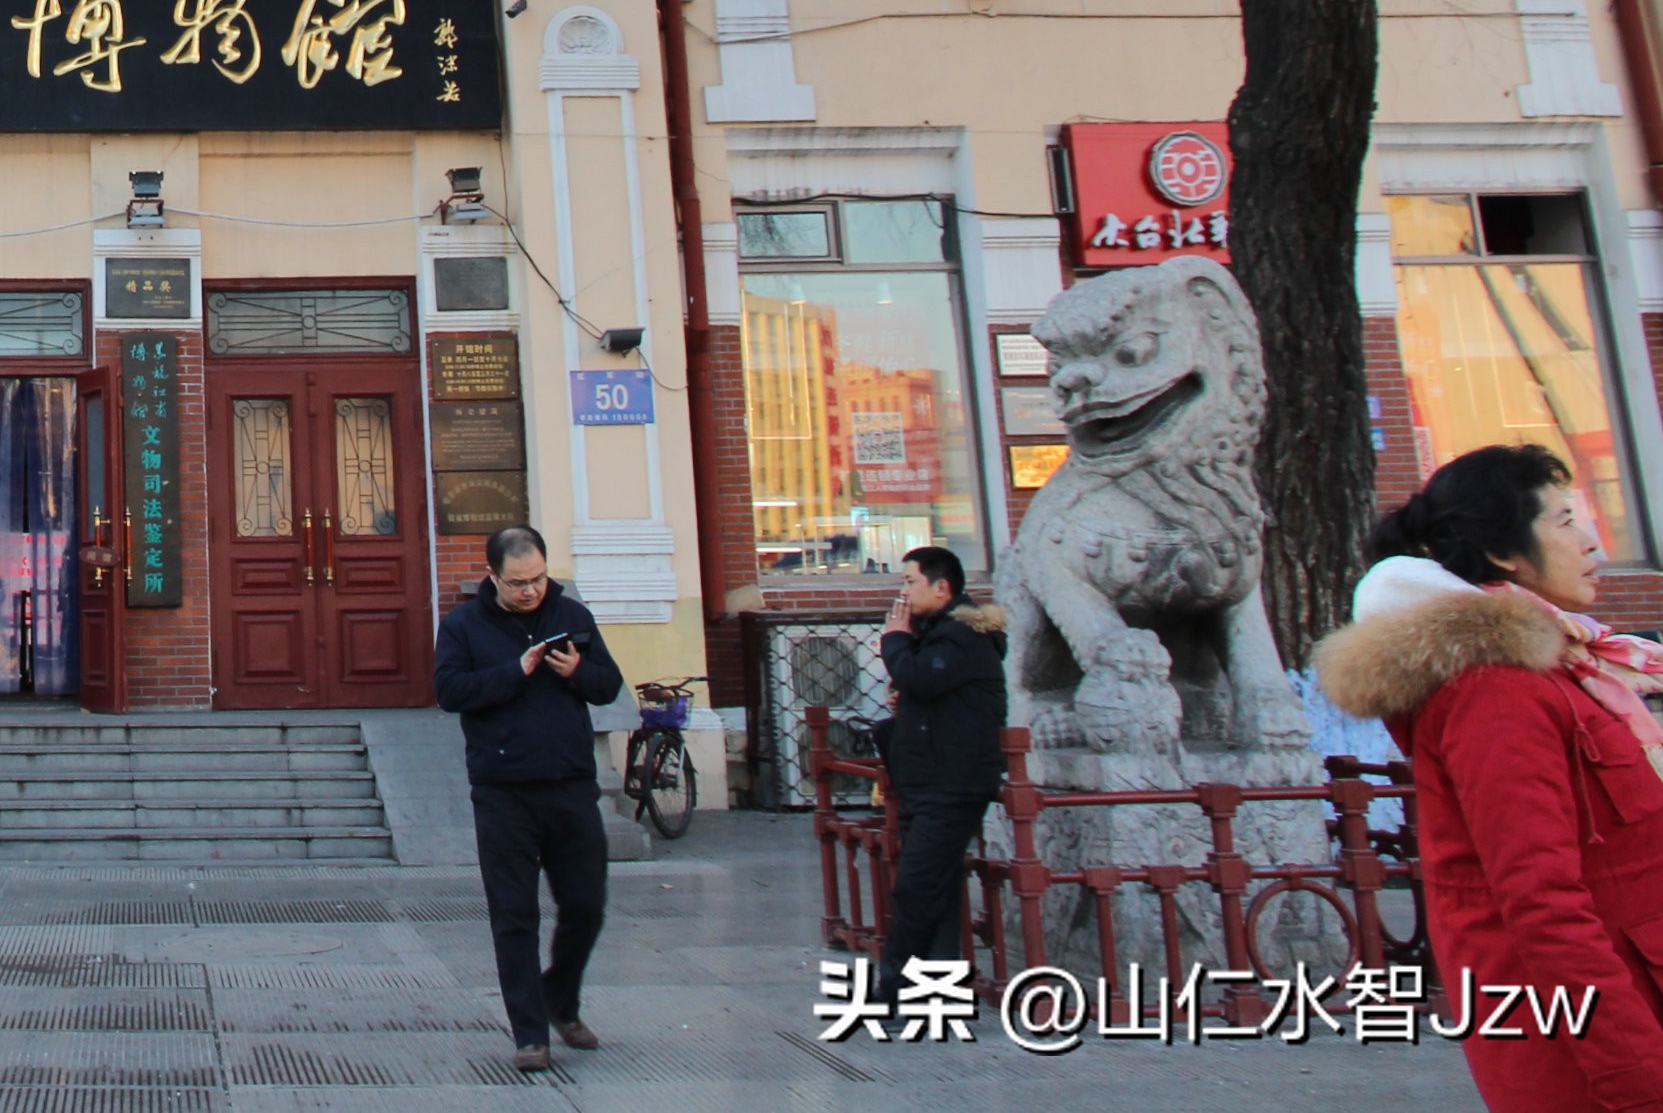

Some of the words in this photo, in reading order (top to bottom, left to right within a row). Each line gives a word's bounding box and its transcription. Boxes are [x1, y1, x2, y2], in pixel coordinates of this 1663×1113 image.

[595, 383, 629, 411] 50
[141, 425, 164, 593] 文物司法鉴定所
